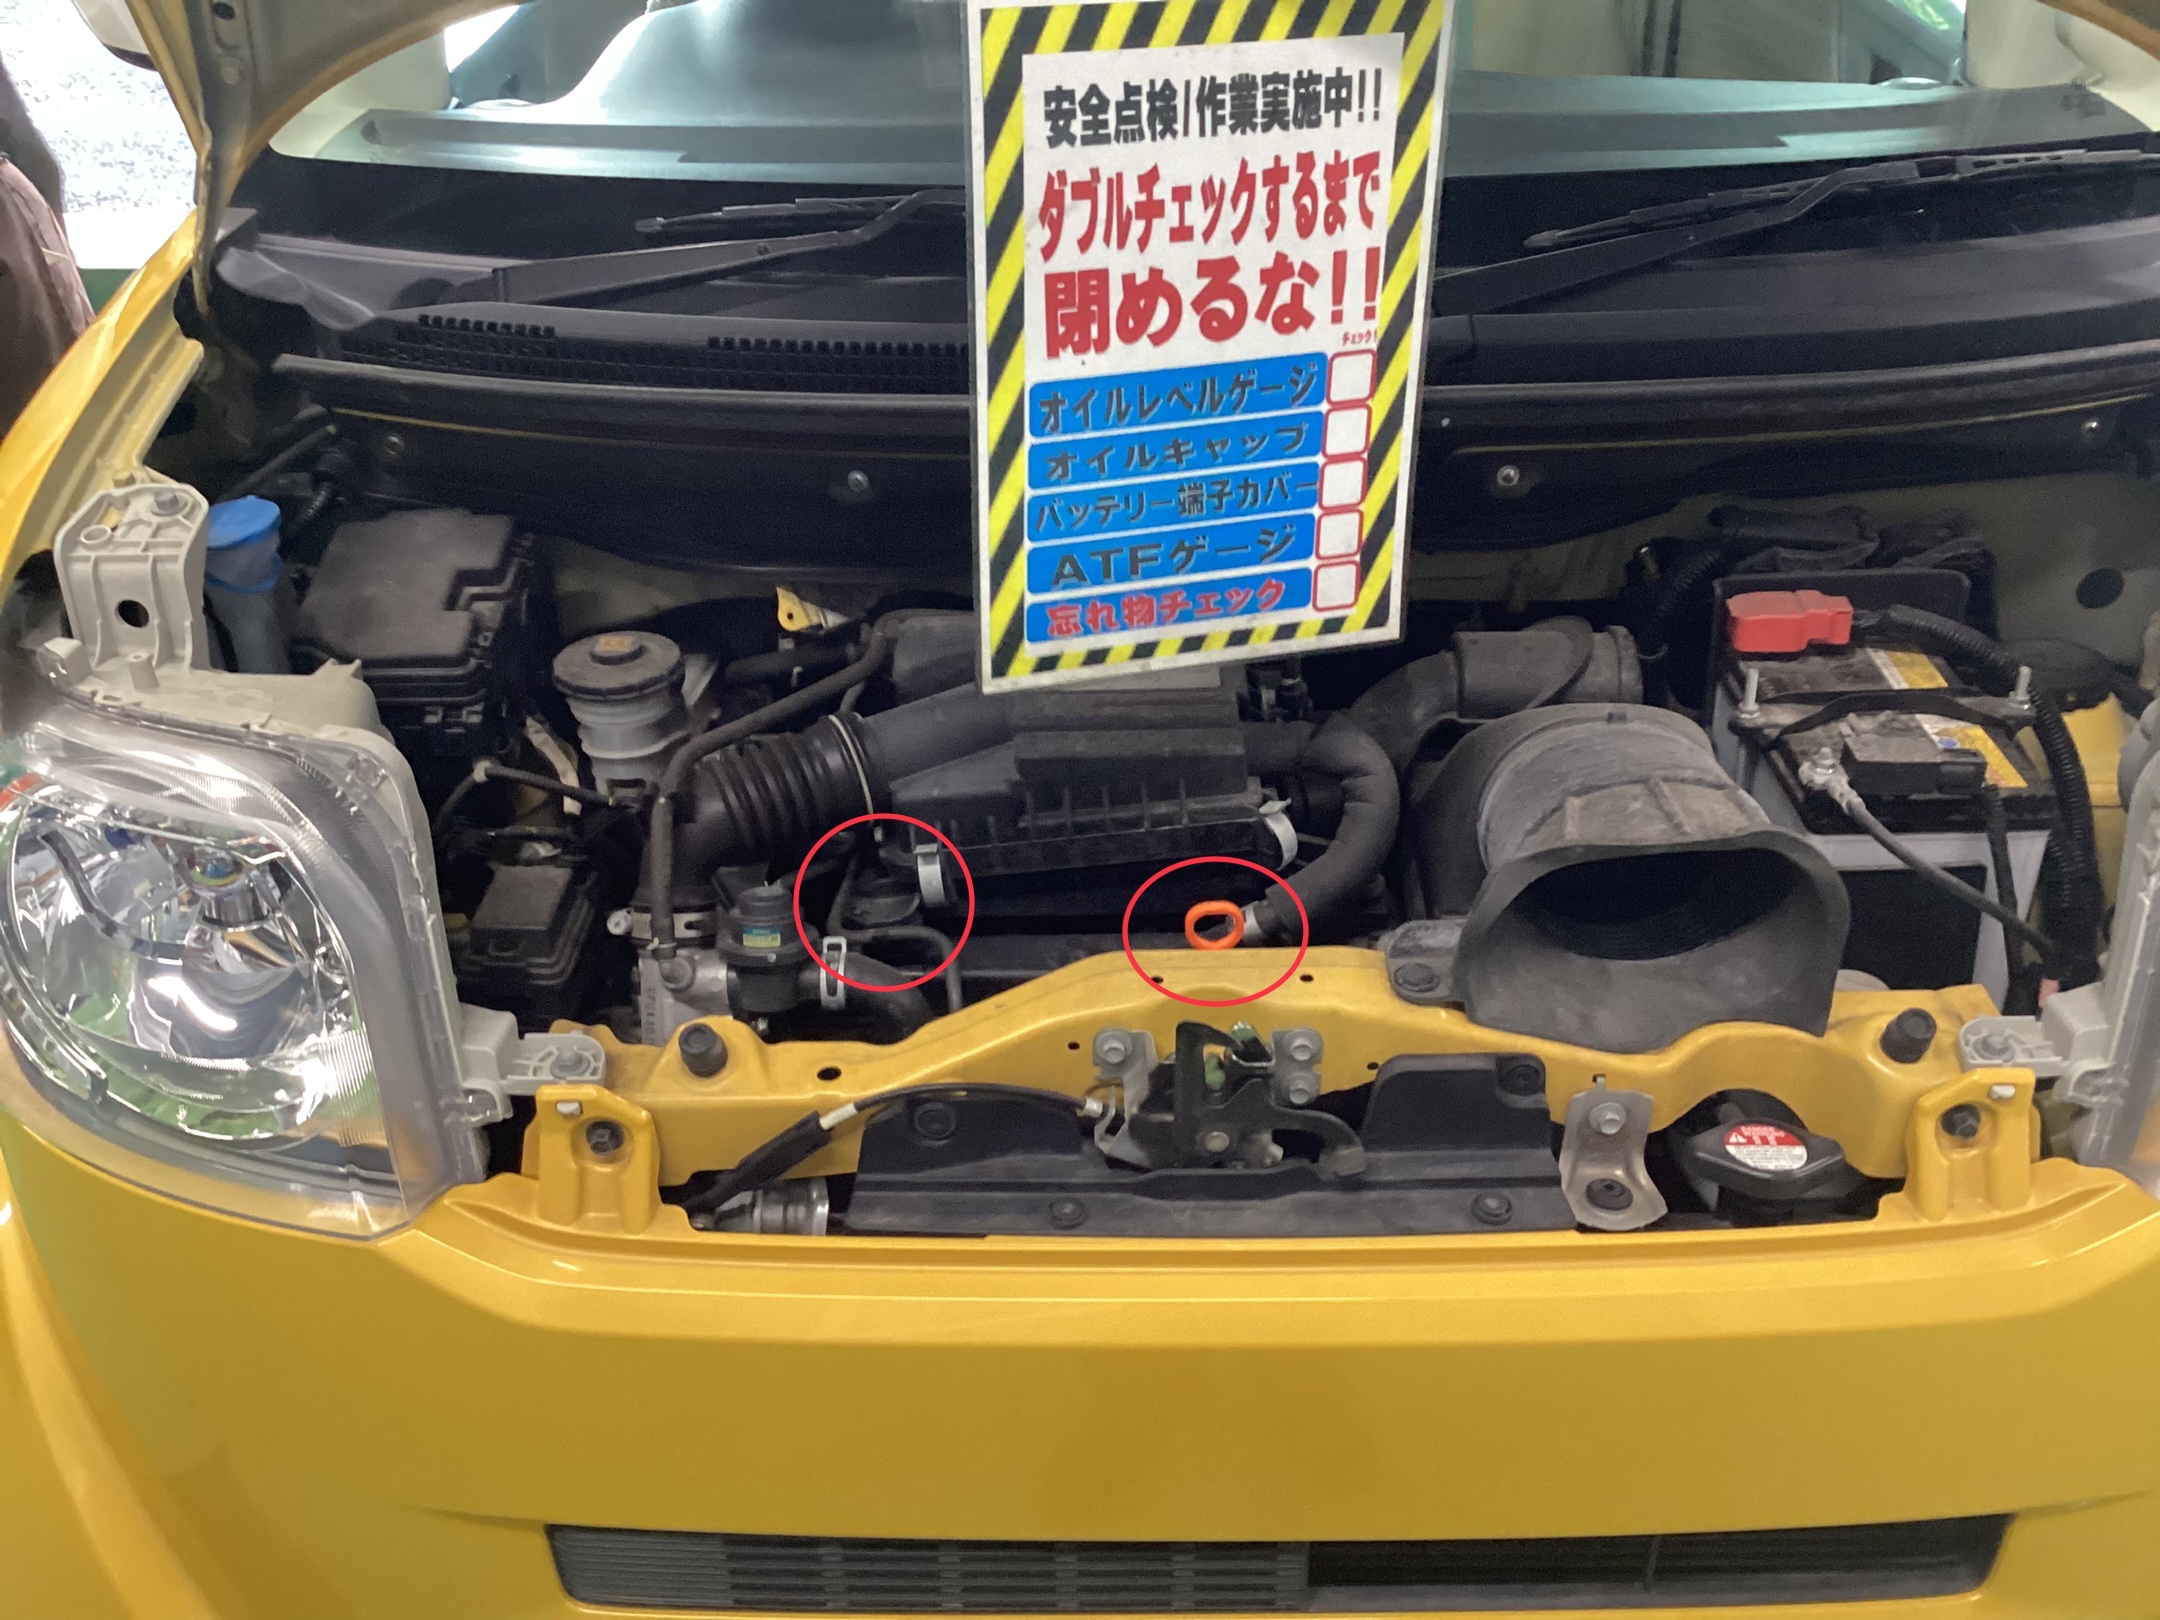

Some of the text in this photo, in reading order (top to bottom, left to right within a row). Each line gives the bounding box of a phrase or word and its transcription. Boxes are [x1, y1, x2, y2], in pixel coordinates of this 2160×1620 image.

[1038, 150, 1381, 263] ダブルチェックするまで
[1044, 246, 1381, 359] 閉めるな!!
[1039, 361, 1317, 436] オイルレベルゲージ
[1045, 423, 1310, 482] オイルキャップ
[1035, 471, 1318, 532] バッテリー端子カバー
[1051, 523, 1296, 589] ATFゲージ
[1046, 577, 1286, 637] 忘れ物チェック
